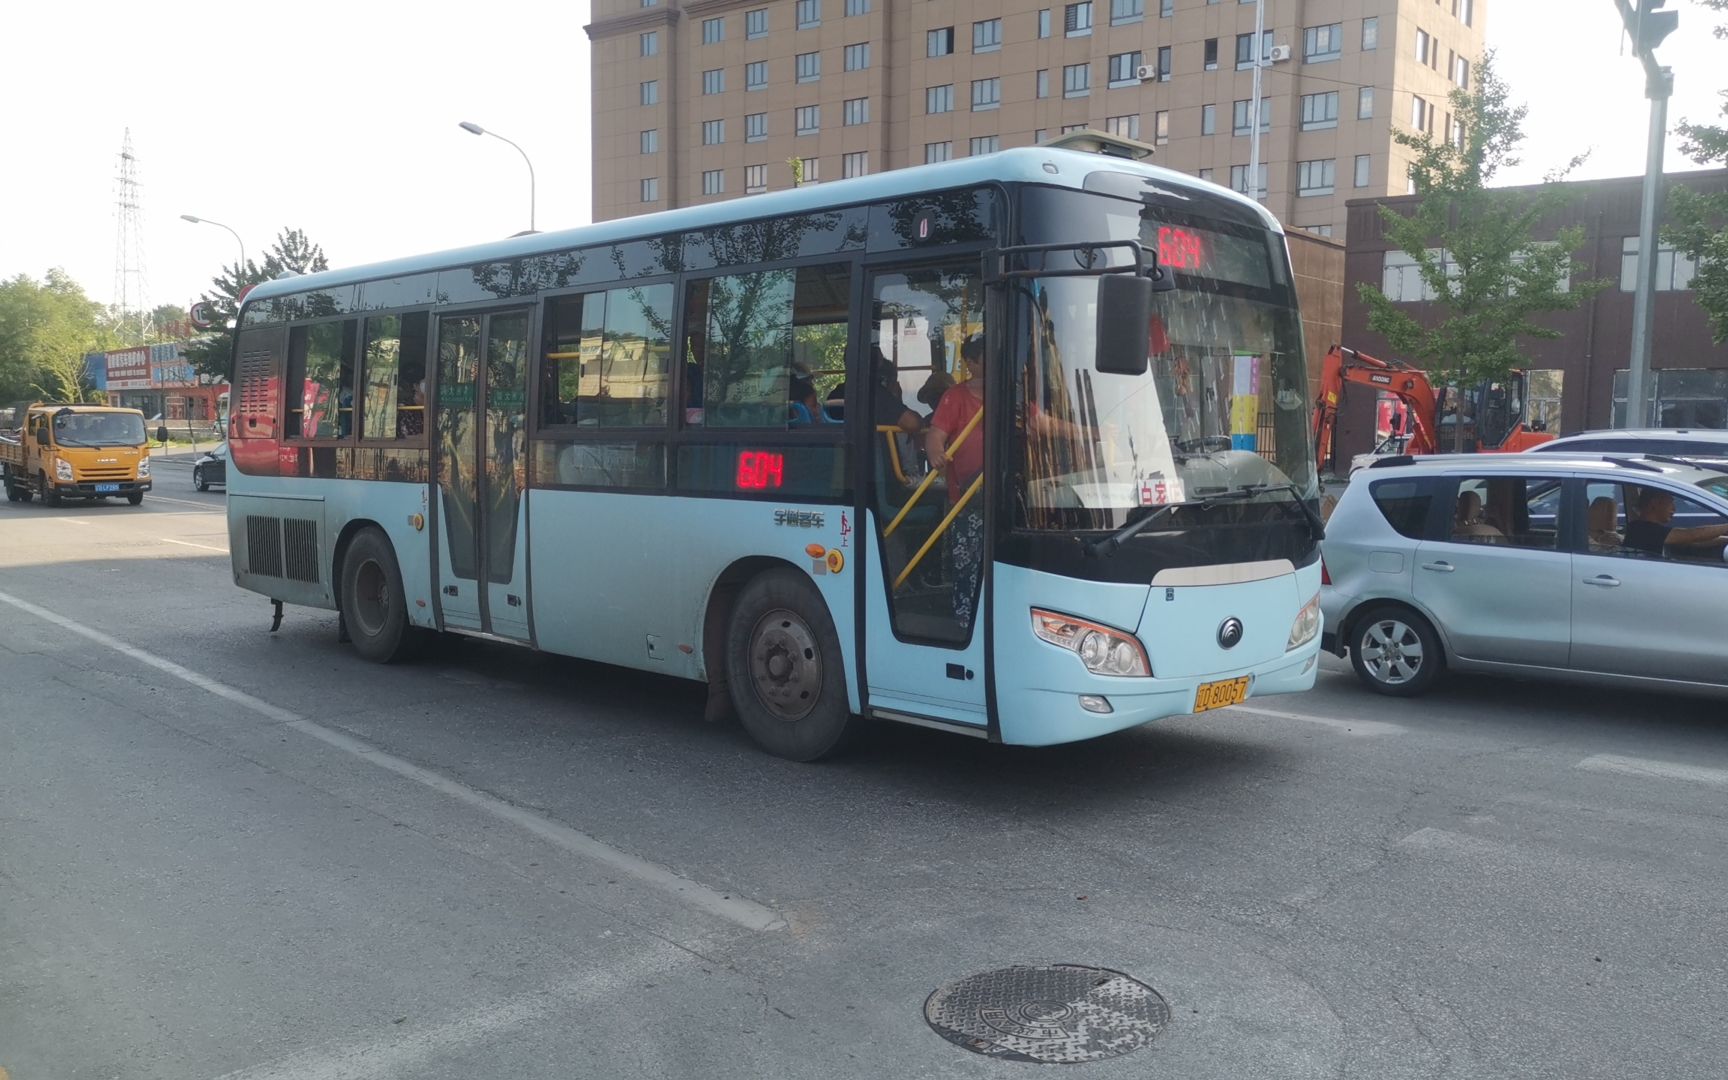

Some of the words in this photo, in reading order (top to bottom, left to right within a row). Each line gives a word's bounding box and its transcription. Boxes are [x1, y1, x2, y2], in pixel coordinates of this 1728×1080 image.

[1158, 226, 1200, 269] 604
[738, 451, 783, 489] 604
[773, 508, 825, 529] 宇通客车
[840, 536, 849, 548] 上
